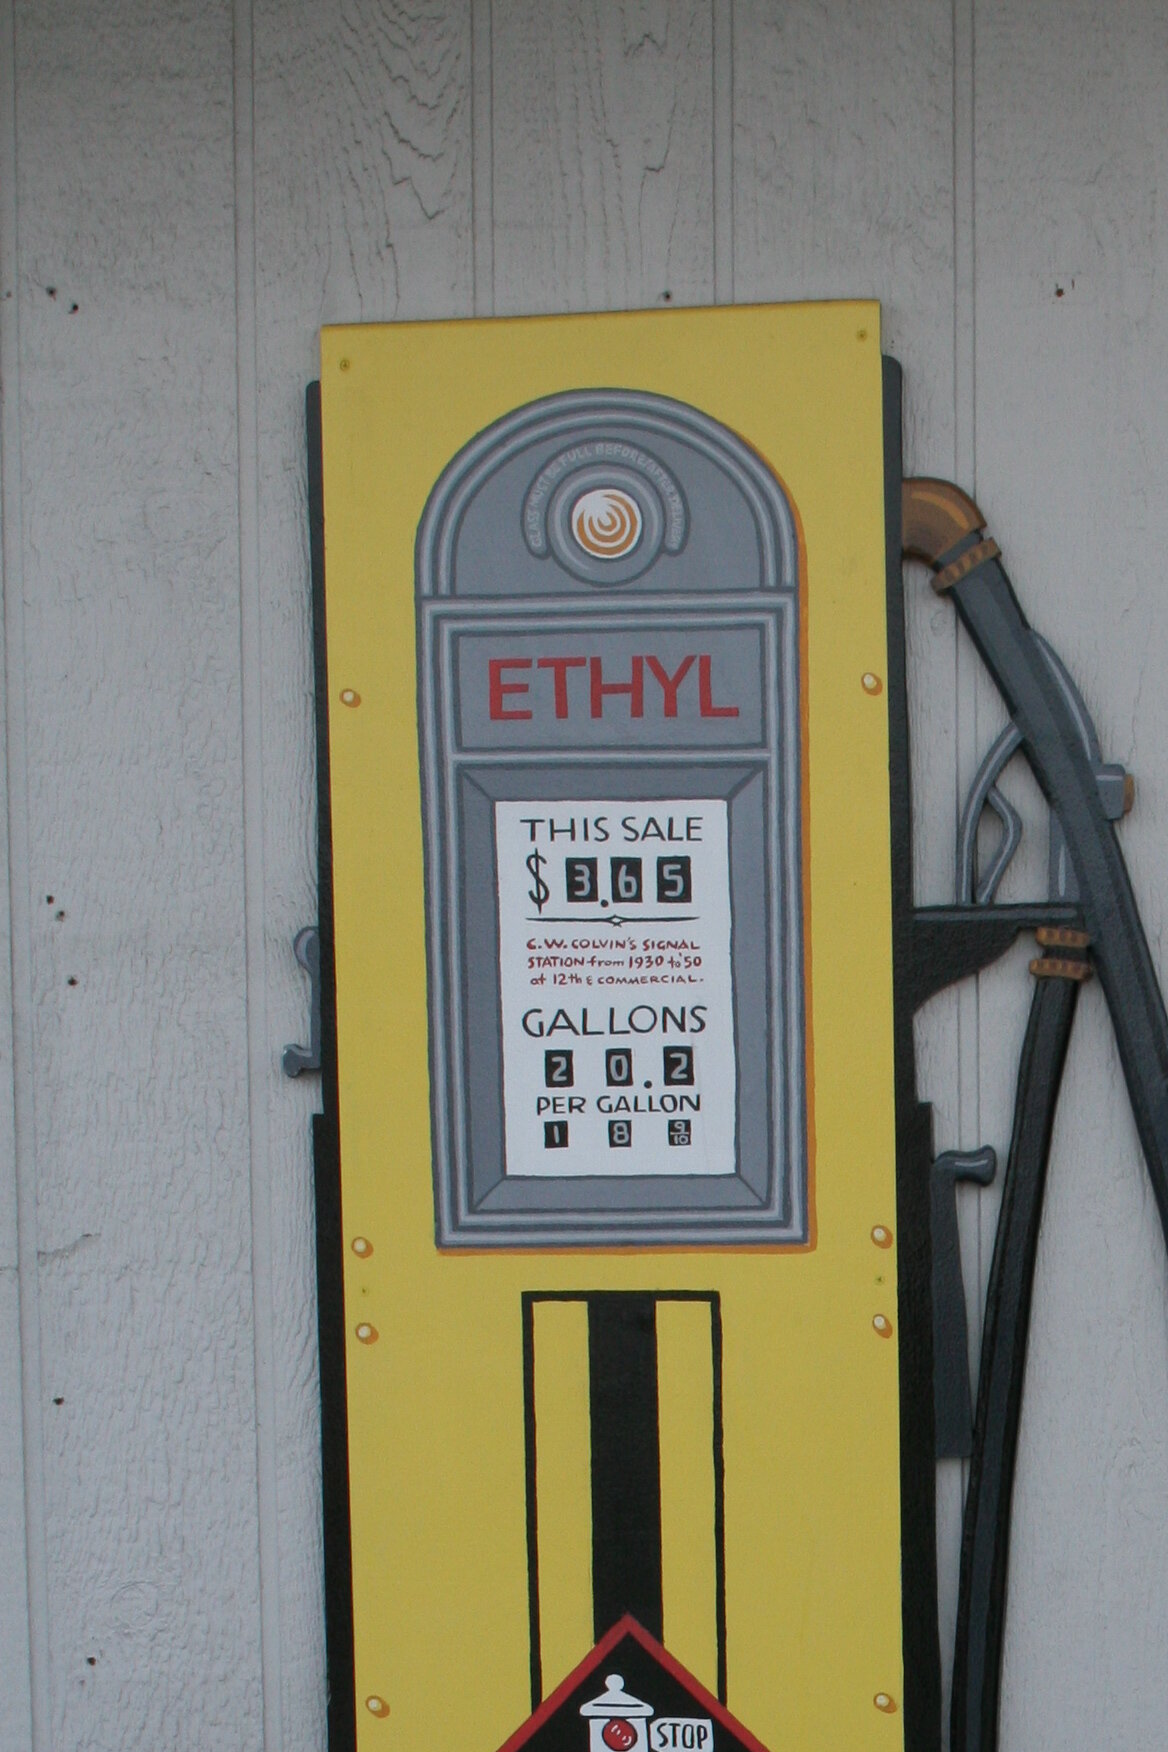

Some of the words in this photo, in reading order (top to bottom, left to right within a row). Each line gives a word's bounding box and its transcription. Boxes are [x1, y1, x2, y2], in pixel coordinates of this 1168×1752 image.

[560, 445, 592, 467] FULL
[529, 477, 551, 507] MUST
[527, 509, 542, 547] GLASS
[488, 655, 739, 720] ETHYL
[520, 816, 610, 842] THIS
[621, 816, 703, 842] SALE
[571, 937, 637, 951] COLVIN'S
[642, 939, 701, 951] SIGNAL
[527, 956, 585, 969] STATION
[586, 955, 625, 968] from
[628, 955, 664, 969] 1930
[667, 956, 681, 969] to
[530, 973, 546, 986] at
[553, 973, 582, 986] 12th
[522, 1005, 708, 1038] GALLONS
[536, 1096, 587, 1116] PER
[596, 1094, 701, 1114] GALLON
[656, 1721, 709, 1751] STOP
